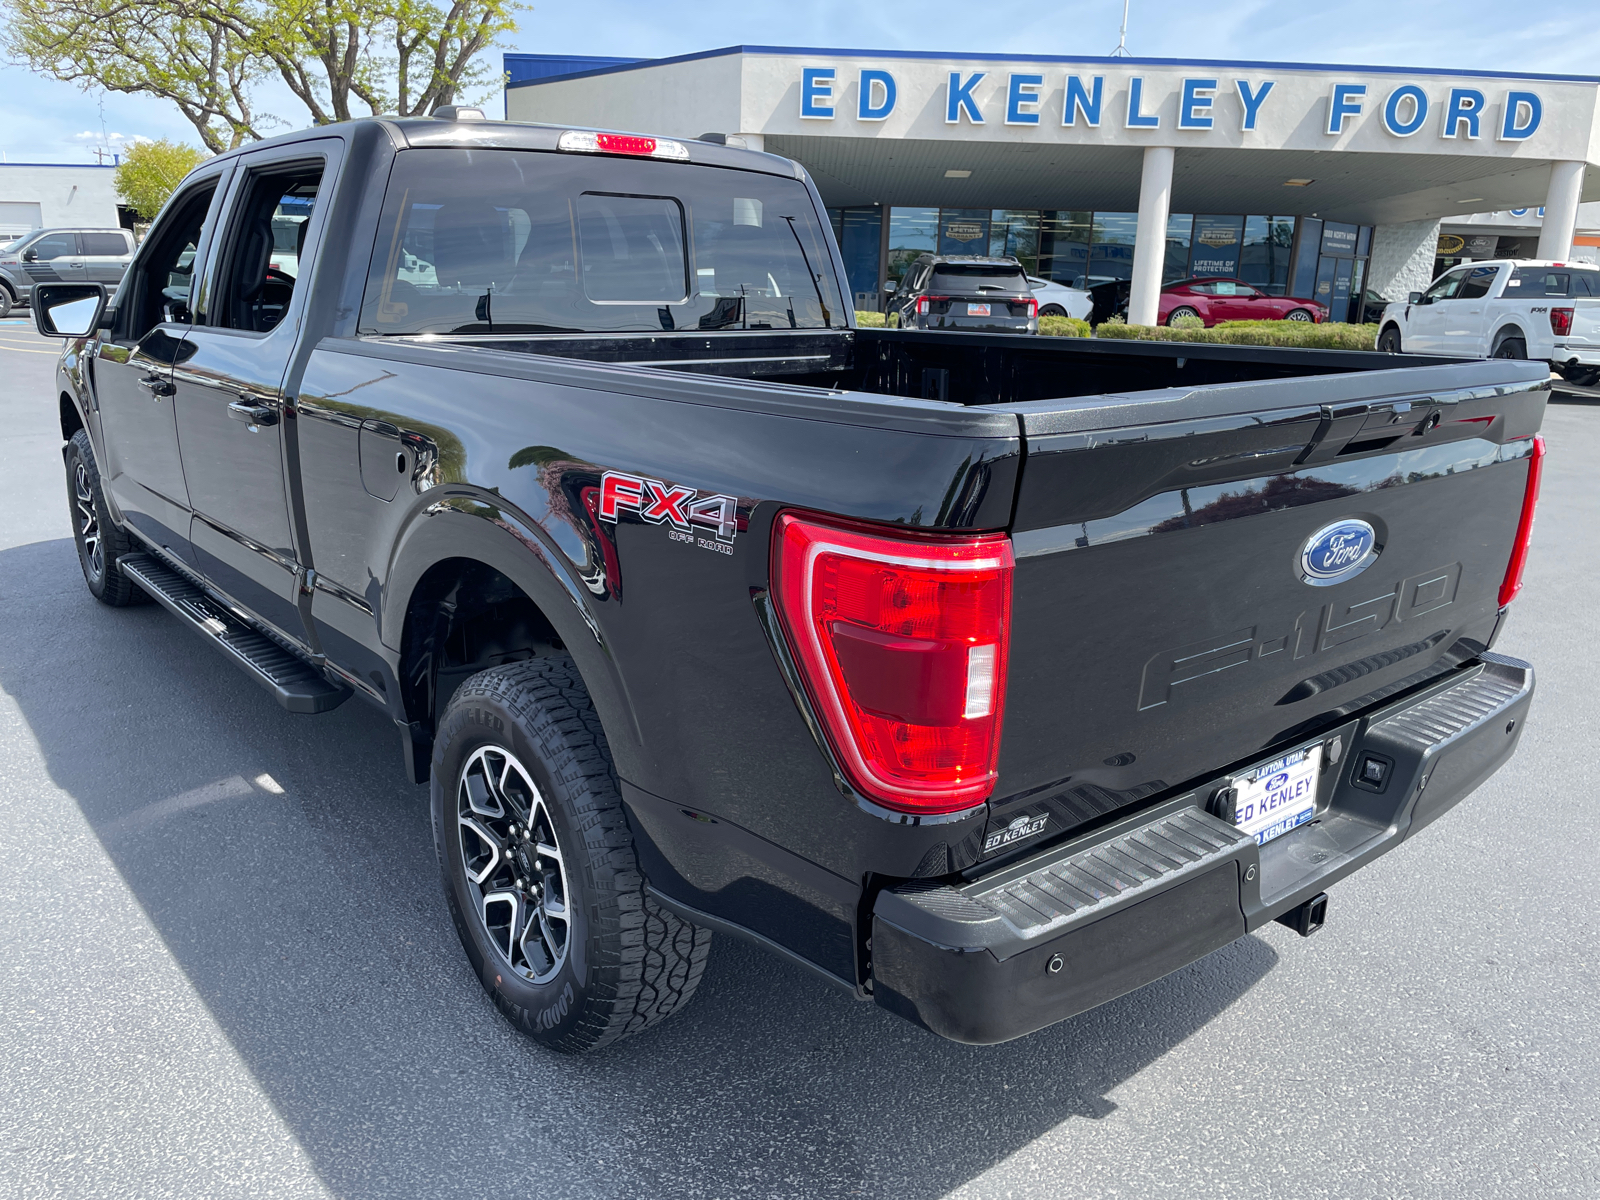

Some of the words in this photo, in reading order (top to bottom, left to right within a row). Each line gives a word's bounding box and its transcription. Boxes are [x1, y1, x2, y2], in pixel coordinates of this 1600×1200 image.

[799, 66, 898, 121] ED
[944, 70, 1278, 132] KENLEY
[1323, 83, 1545, 141] FORD
[599, 470, 738, 544] FX4
[668, 530, 694, 543] OFF
[697, 537, 734, 555] ROAD
[1323, 532, 1364, 567] Ford
[1137, 561, 1463, 712] F-150
[1286, 750, 1304, 765] UTAH
[1235, 803, 1254, 825] ED
[1259, 775, 1313, 815] KENLEY
[985, 835, 1001, 849] ED
[1003, 817, 1048, 842] KENLEY
[1262, 816, 1299, 842] KENLEY
